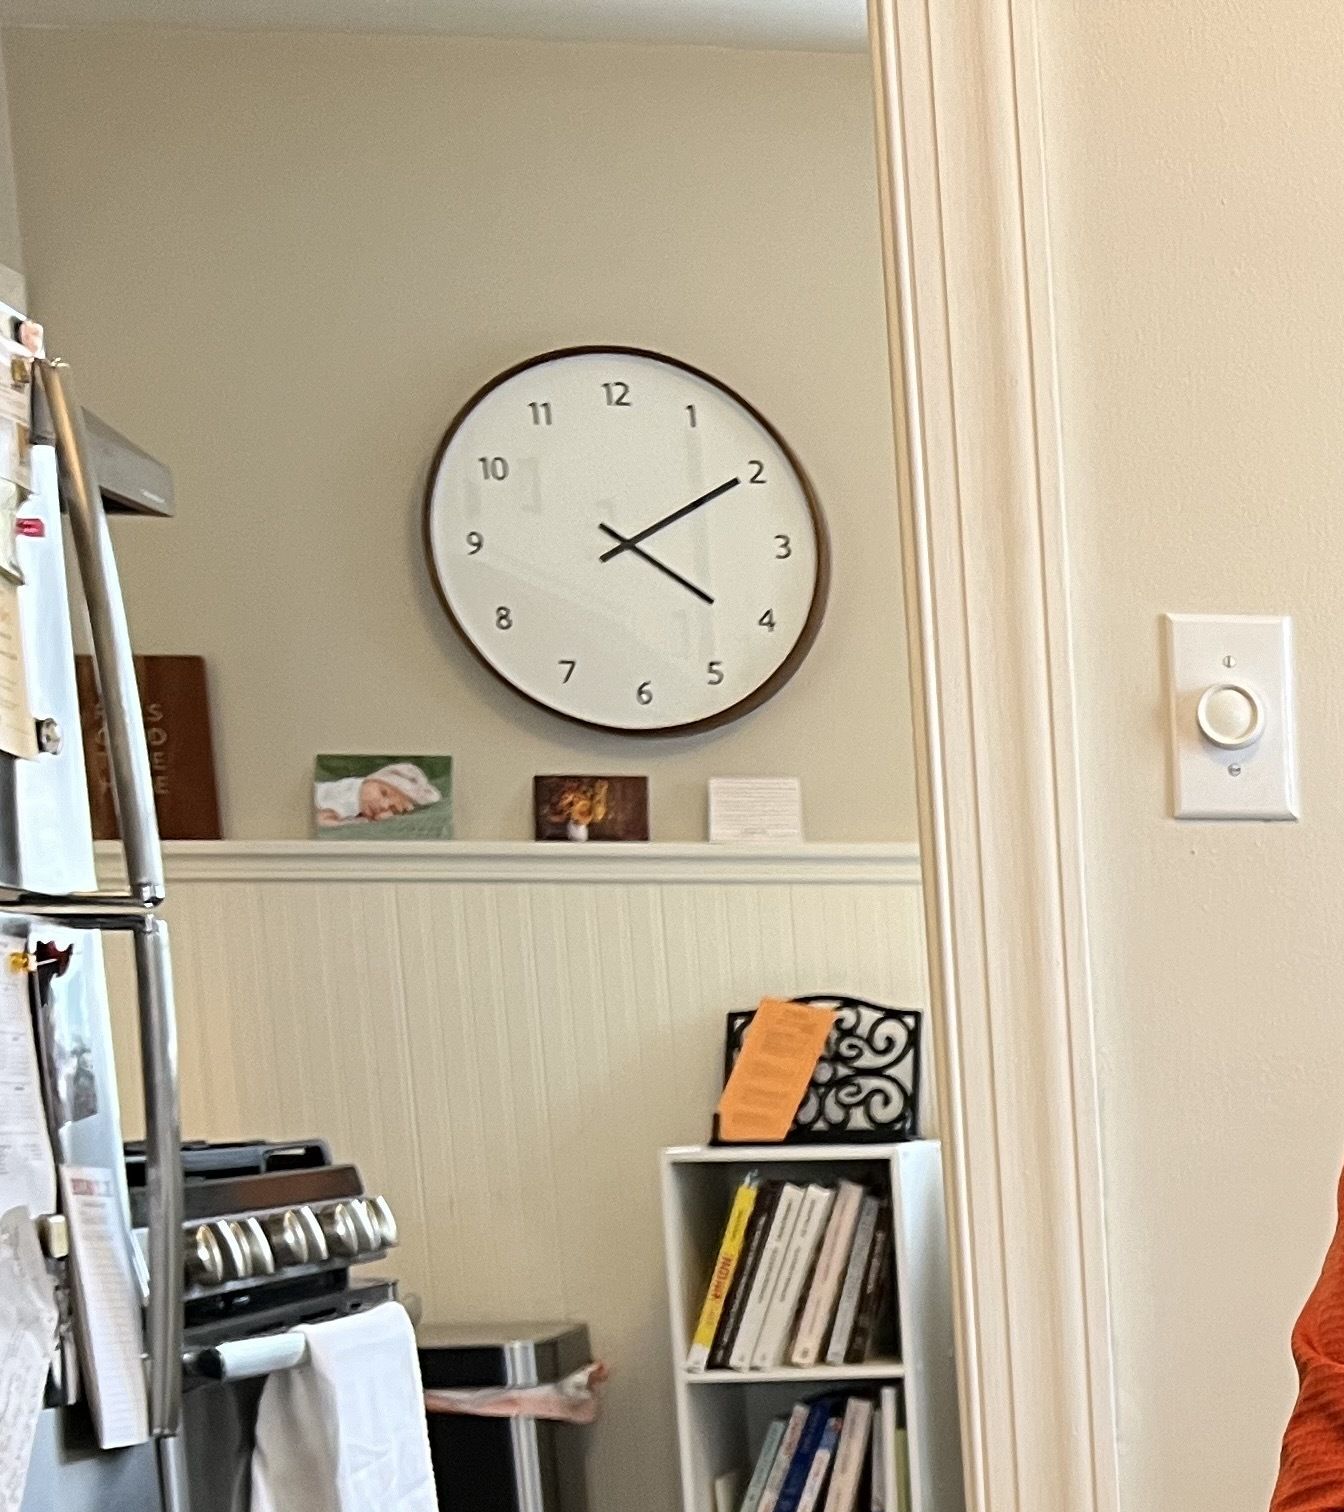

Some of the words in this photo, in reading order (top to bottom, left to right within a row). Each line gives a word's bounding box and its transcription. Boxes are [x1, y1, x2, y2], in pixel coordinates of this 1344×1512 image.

[601, 381, 632, 407] 12
[528, 401, 553, 426] 11
[686, 404, 697, 428] 1
[478, 456, 509, 481] 10
[748, 460, 767, 485] 2
[466, 531, 484, 556] 9
[775, 534, 793, 560] 3
[495, 605, 513, 631] 8
[758, 607, 776, 633] 4
[558, 659, 577, 684] 7
[706, 660, 725, 686] 5
[635, 680, 653, 705] 6
